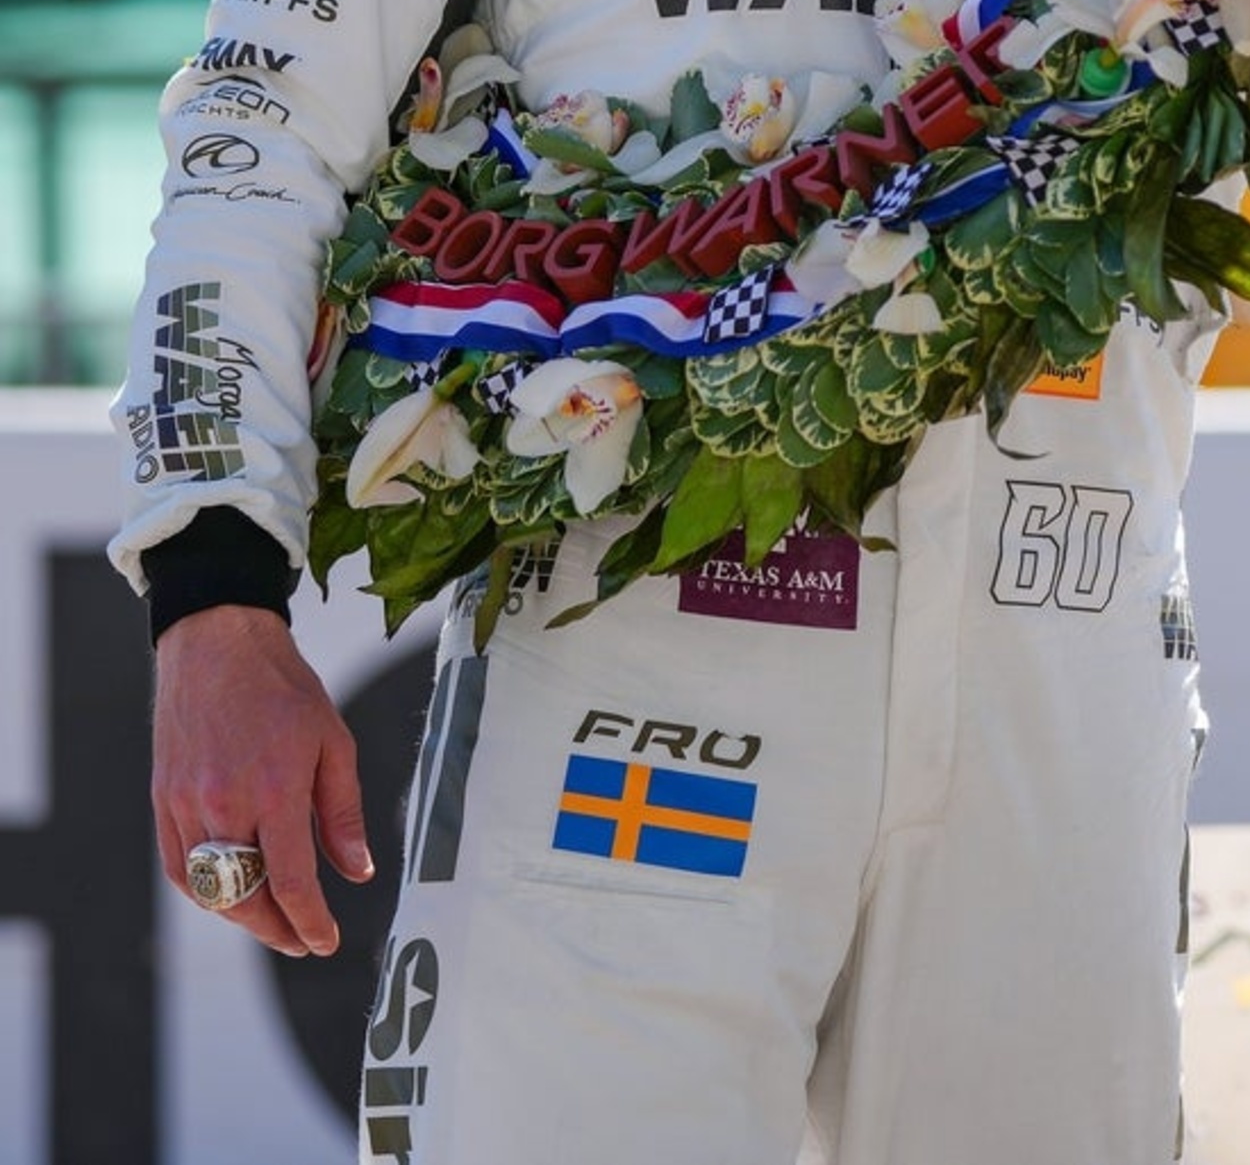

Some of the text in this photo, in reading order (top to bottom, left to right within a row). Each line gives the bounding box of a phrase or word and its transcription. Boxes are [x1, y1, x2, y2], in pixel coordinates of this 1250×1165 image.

[990, 480, 1134, 613] 60
[699, 560, 845, 592] TEXAS A&M
[696, 580, 844, 605] UNIVERSITY
